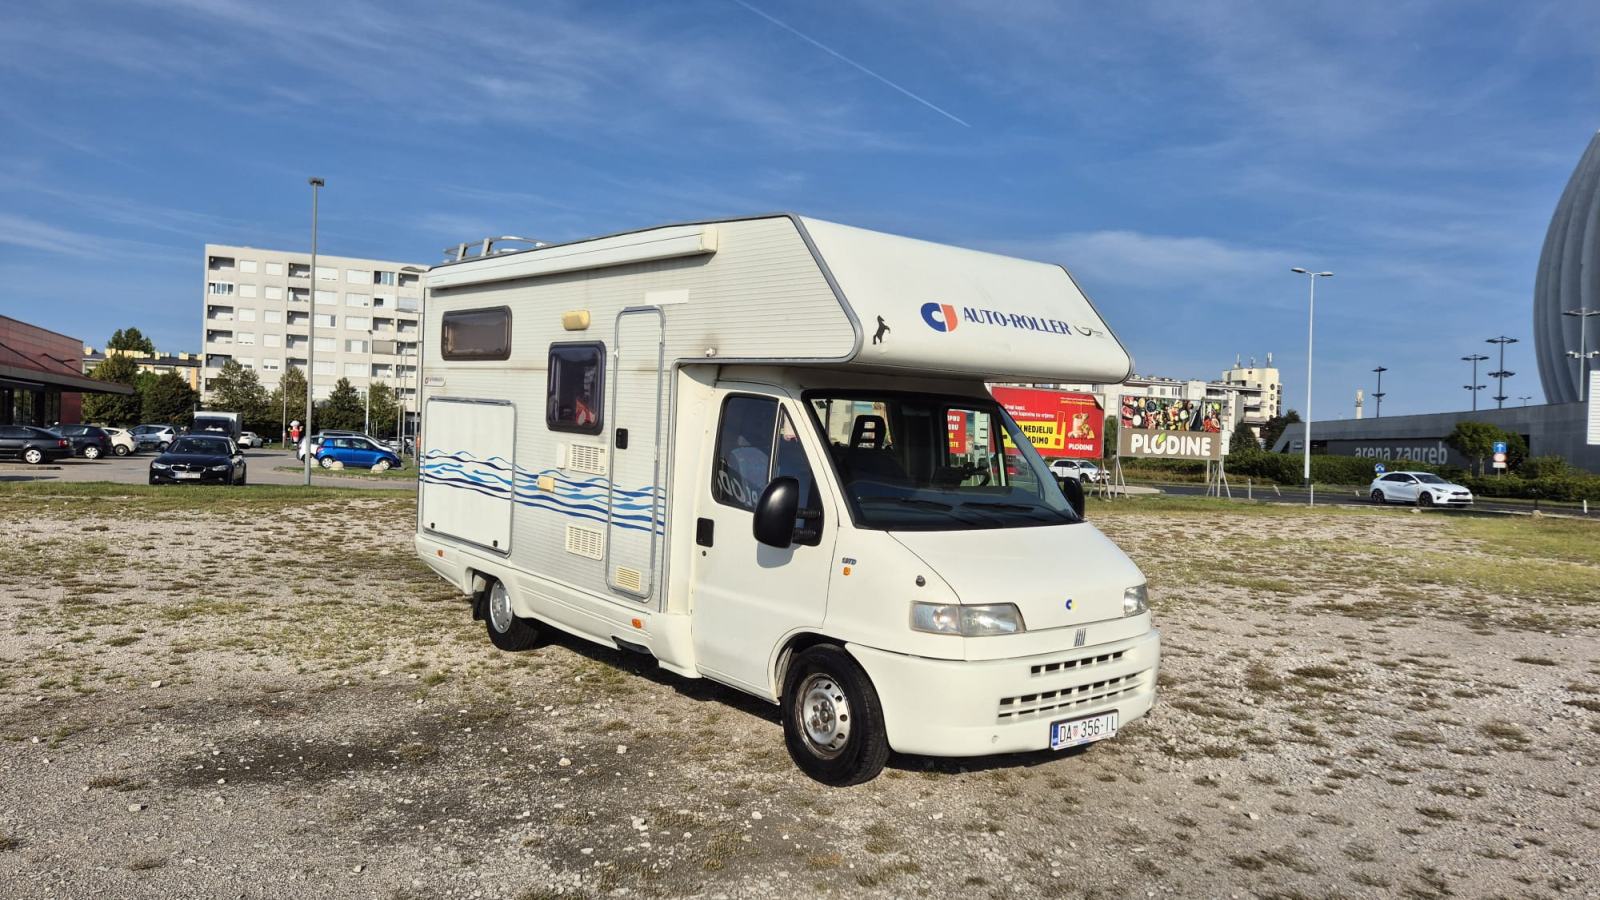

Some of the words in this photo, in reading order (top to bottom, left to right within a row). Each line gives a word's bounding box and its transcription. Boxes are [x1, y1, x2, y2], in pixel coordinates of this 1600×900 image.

[963, 307, 1072, 335] AUTO-ROLLER
[1023, 425, 1054, 434] NEDJELJU
[1068, 443, 1093, 451] PLODINE
[1131, 432, 1211, 456] PLODINE
[1355, 447, 1391, 461] arena
[1395, 441, 1448, 464] zagreb
